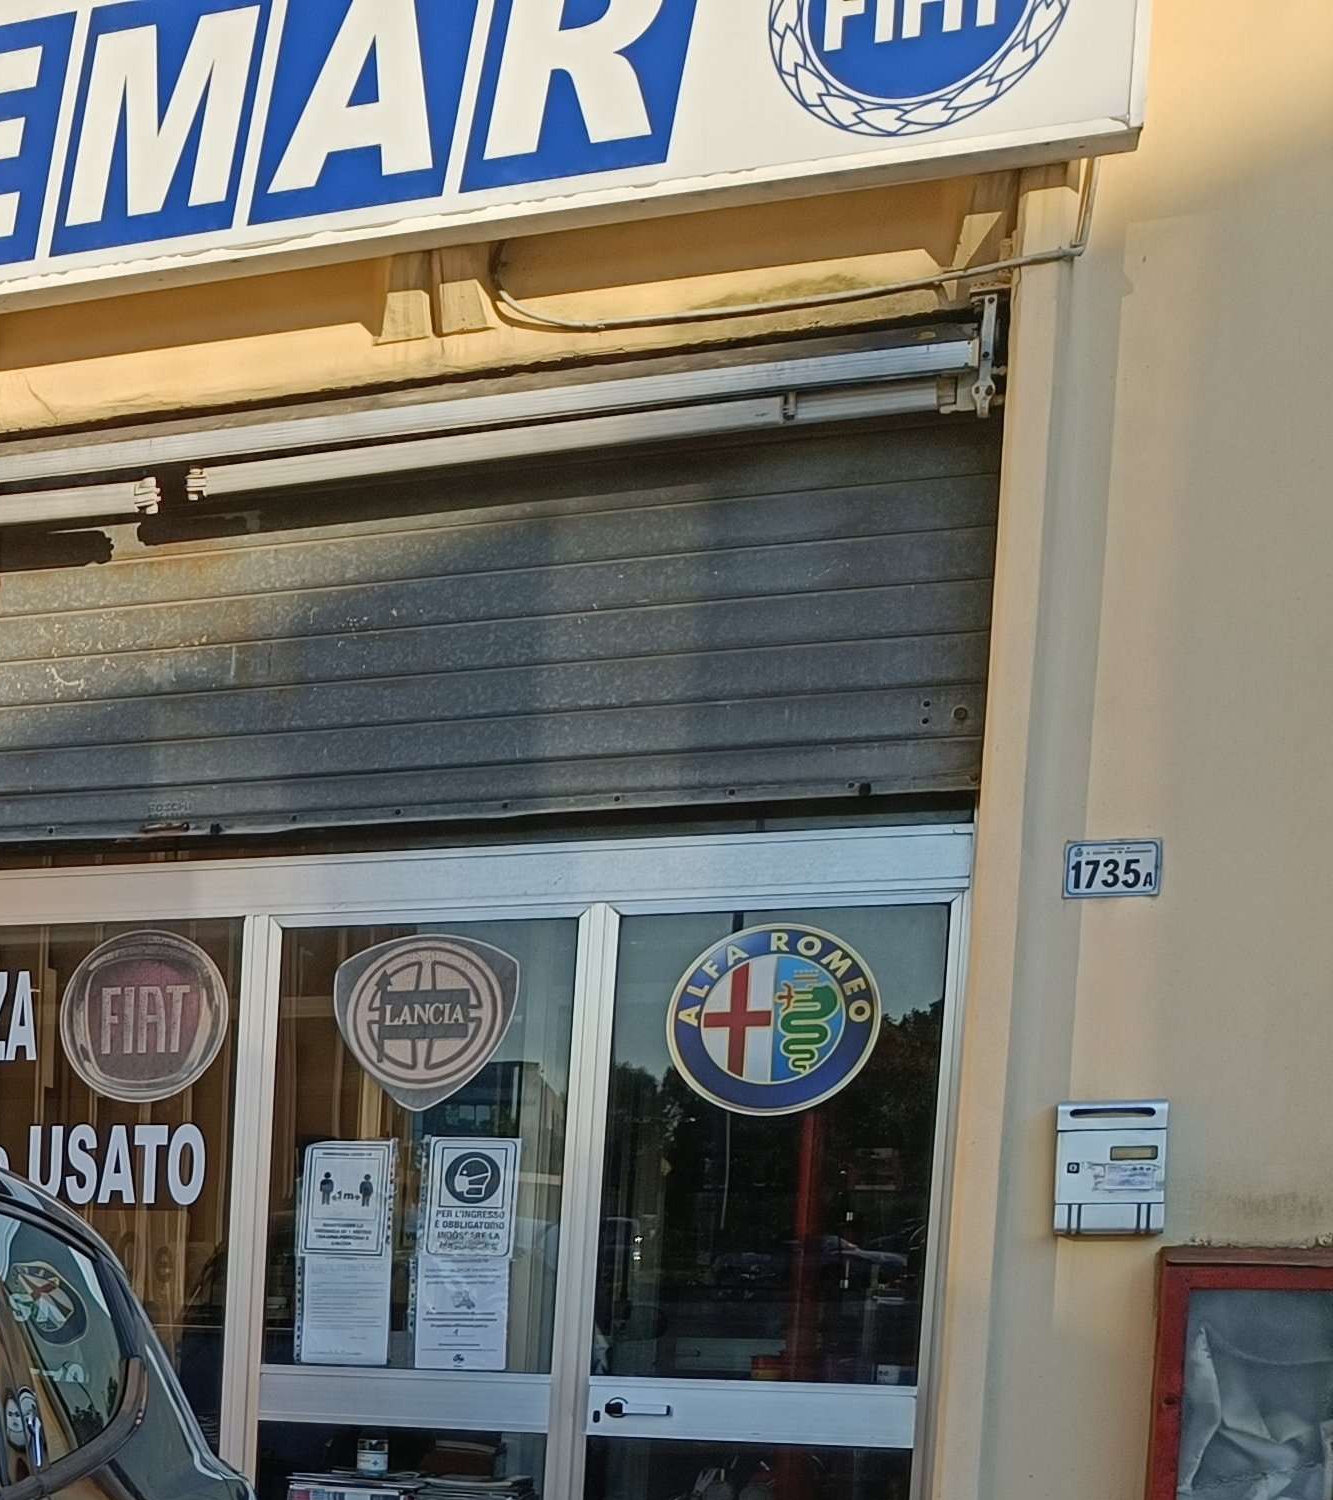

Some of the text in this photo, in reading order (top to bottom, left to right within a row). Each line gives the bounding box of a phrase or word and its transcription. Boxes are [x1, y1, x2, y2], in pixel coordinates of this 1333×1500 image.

[677, 931, 872, 1027] ALFA ROMEO
[100, 984, 190, 1055] FIAT
[384, 1002, 465, 1026] LANCIA
[27, 1122, 206, 1206] USATO
[435, 1209, 505, 1219] PER L'INGRESSO
[442, 1220, 505, 1229] OBBLIGATORIO
